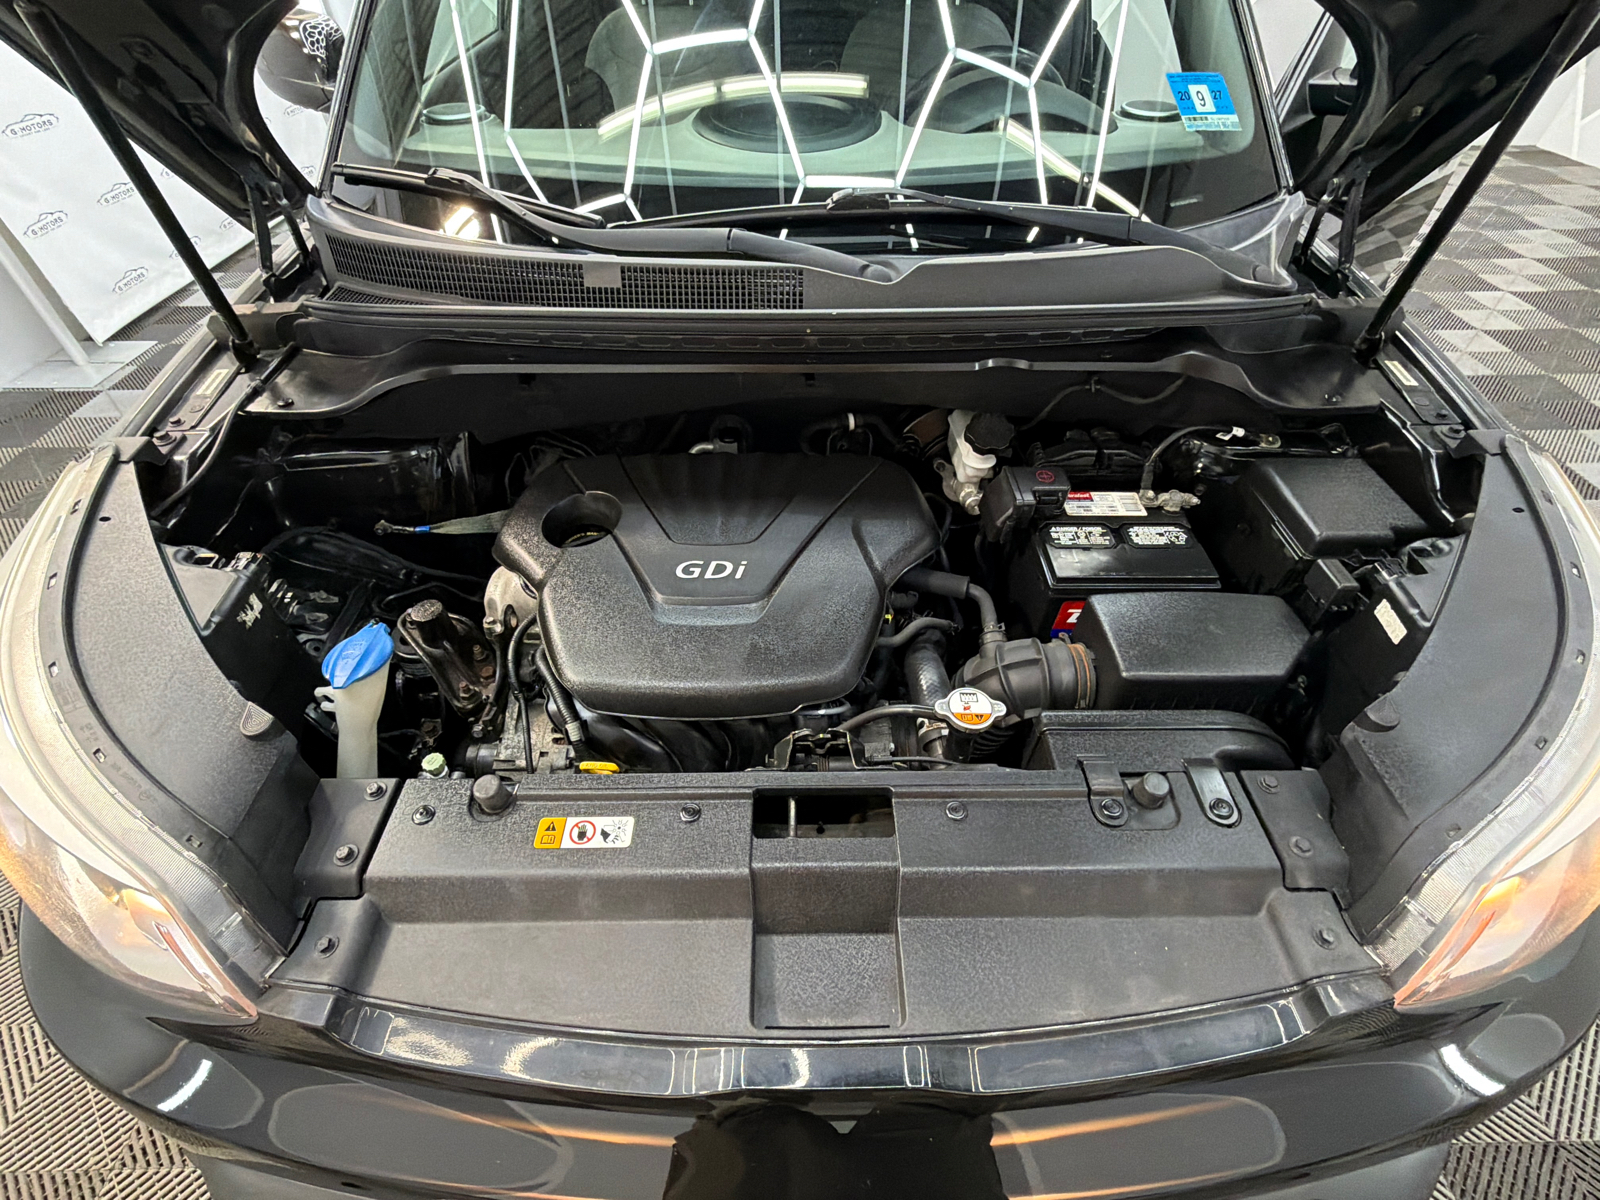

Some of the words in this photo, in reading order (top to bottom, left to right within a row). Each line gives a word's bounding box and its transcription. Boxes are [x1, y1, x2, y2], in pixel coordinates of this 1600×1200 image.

[1178, 90, 1191, 101] 20
[1195, 90, 1207, 107] 9
[1211, 90, 1222, 100] 27
[19, 119, 54, 134] MOTORS
[38, 216, 64, 233] MOTORS
[675, 560, 748, 580] GDi
